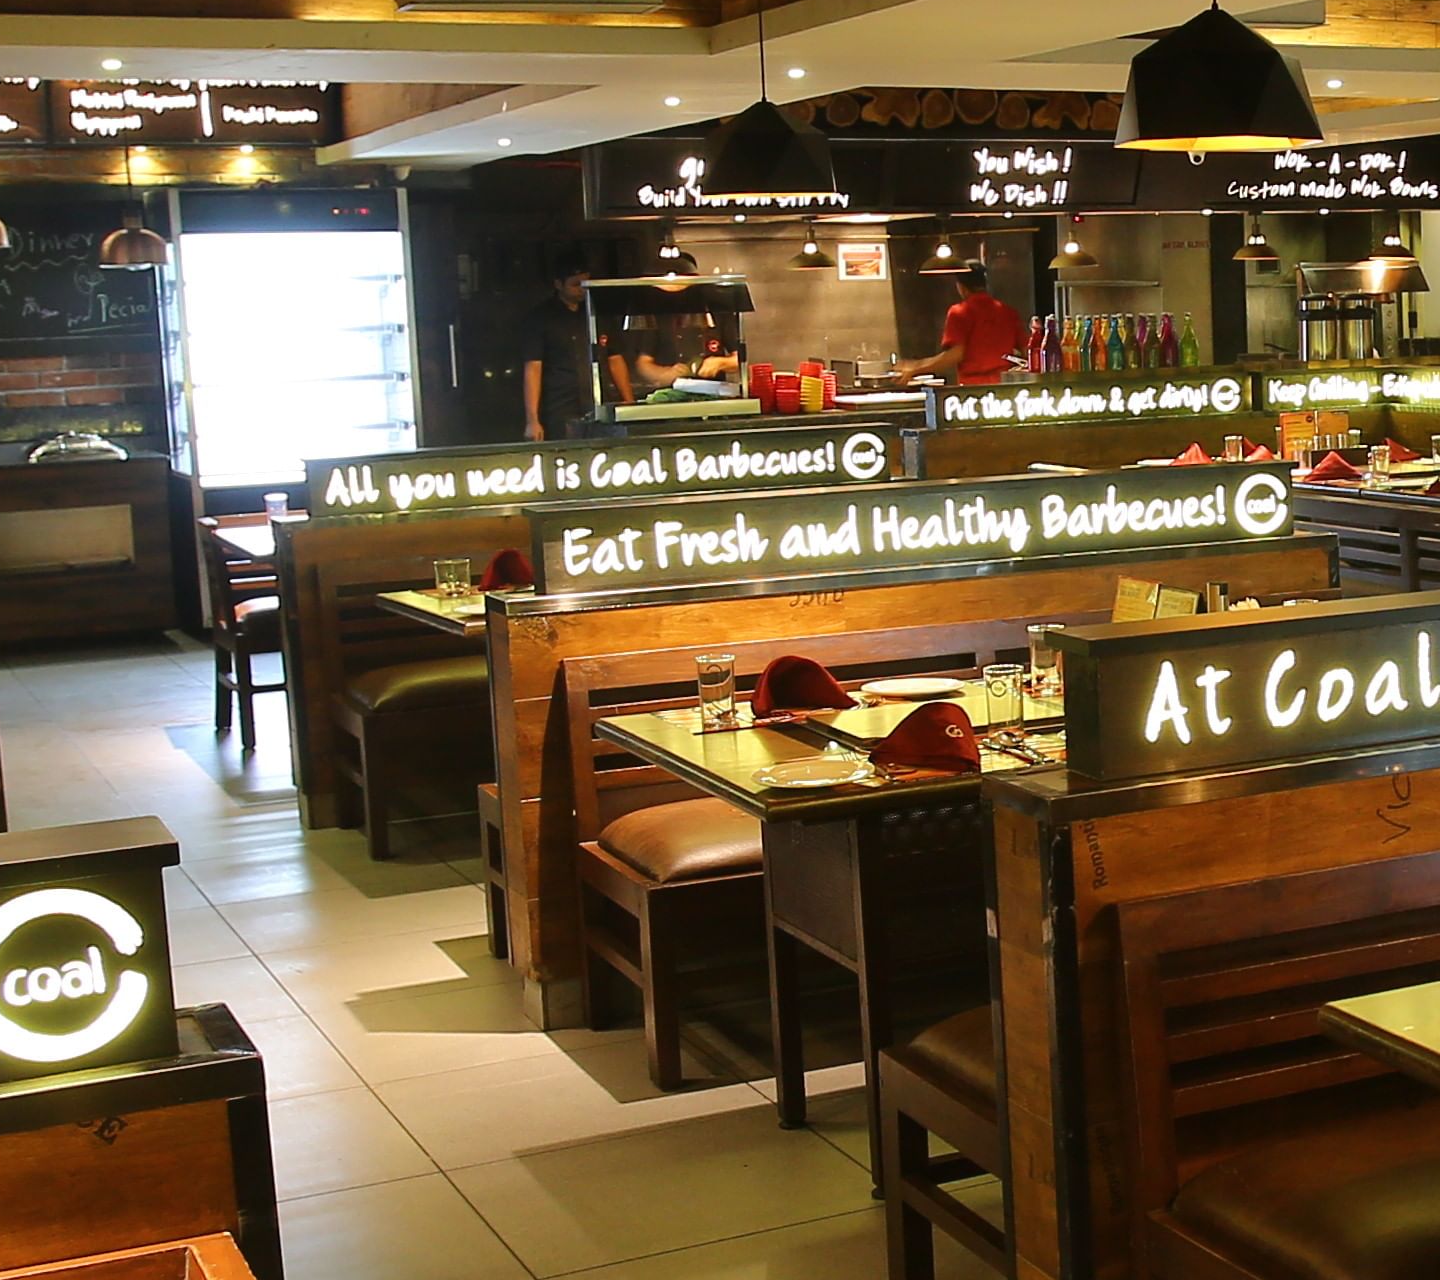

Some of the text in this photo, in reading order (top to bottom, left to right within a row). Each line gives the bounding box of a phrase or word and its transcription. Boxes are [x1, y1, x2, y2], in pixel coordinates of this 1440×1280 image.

[973, 147, 1009, 174] You
[1328, 152, 1341, 174] A
[638, 185, 686, 208] Build
[970, 179, 999, 206] We
[1227, 181, 1296, 200] Custom
[1299, 179, 1346, 199] made
[1389, 176, 1440, 199] Bowls
[325, 441, 835, 510] All you need is Coal Barbecues!
[564, 485, 1226, 576] Eat Fresh and Healthy Barbecues!
[1145, 661, 1231, 744] At
